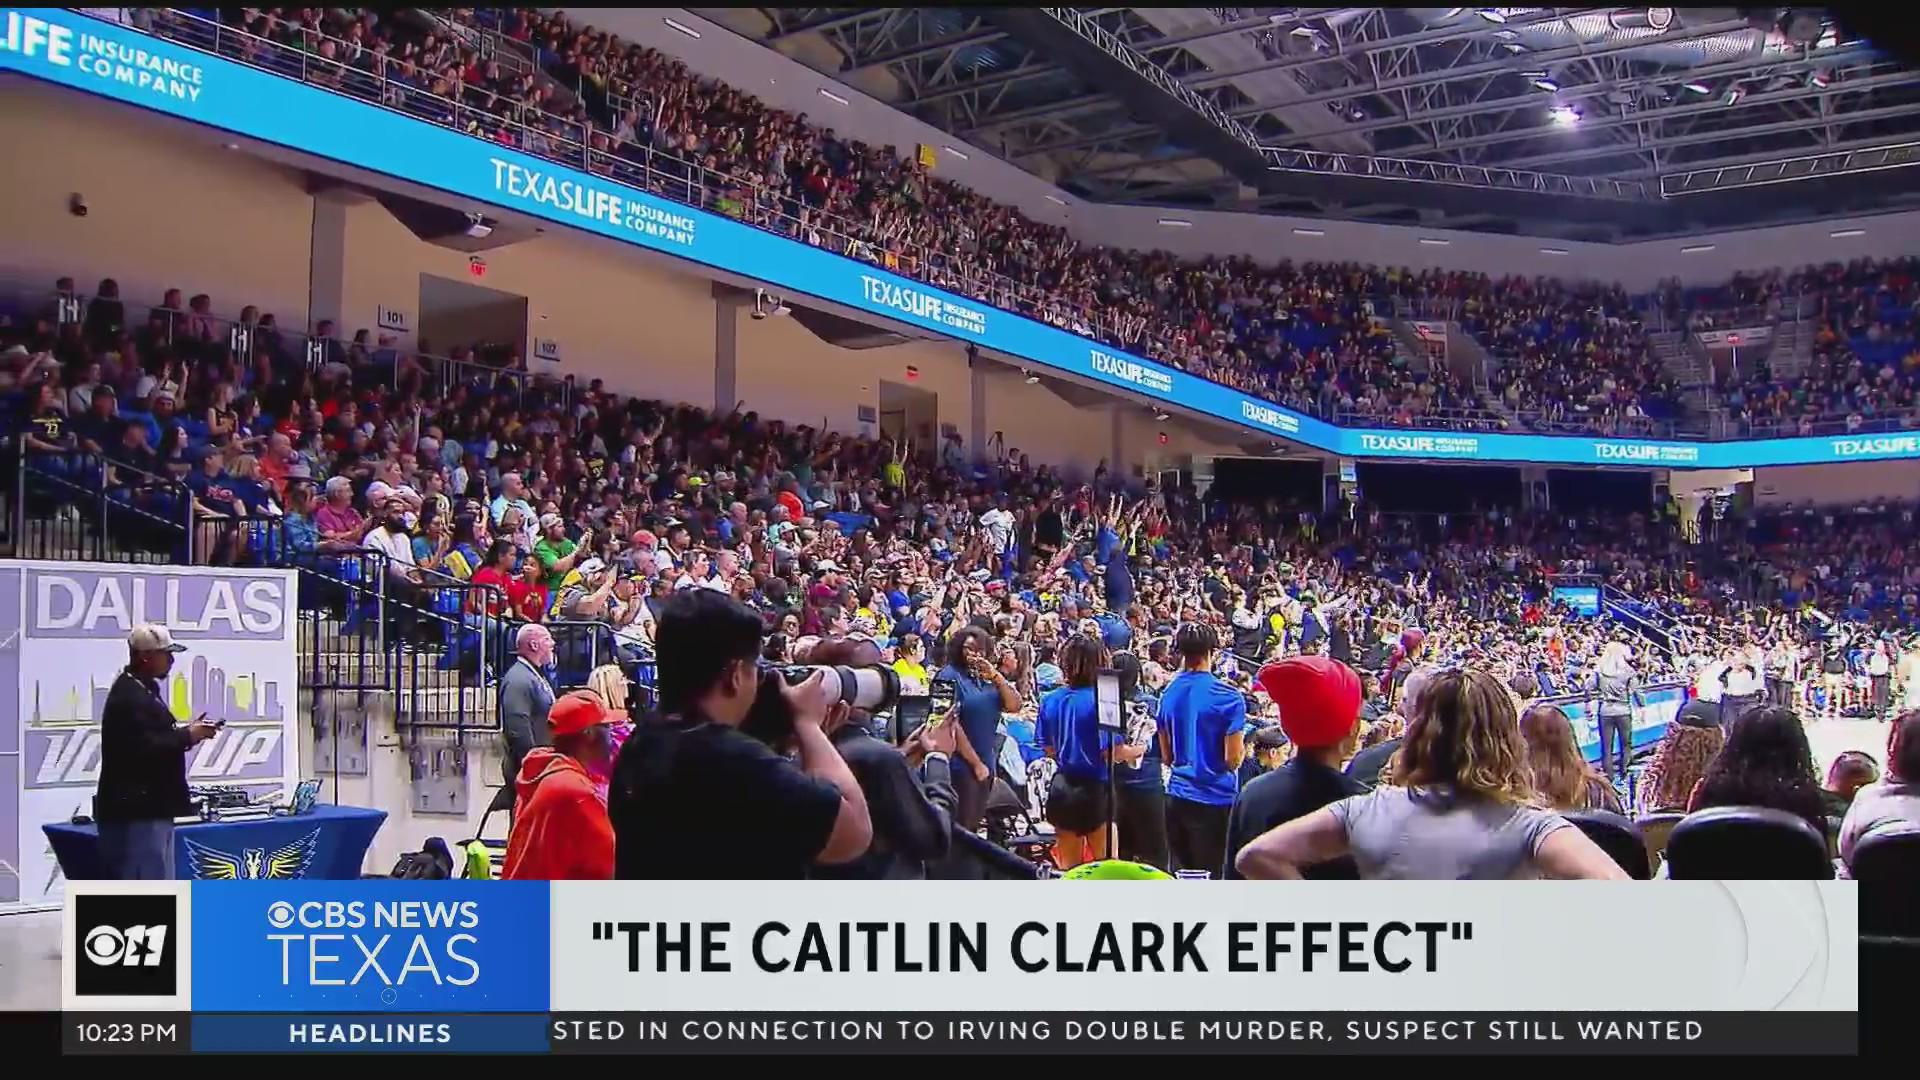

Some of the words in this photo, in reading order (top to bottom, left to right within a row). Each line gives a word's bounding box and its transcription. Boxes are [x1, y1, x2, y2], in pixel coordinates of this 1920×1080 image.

[0, 11, 72, 66] IFE
[80, 33, 203, 85] INSURANCE
[78, 54, 201, 102] COMPANY
[625, 215, 695, 246] COMPANY
[626, 200, 695, 232] INSURANCE
[387, 311, 403, 324] 101
[37, 575, 282, 634] DALLAS
